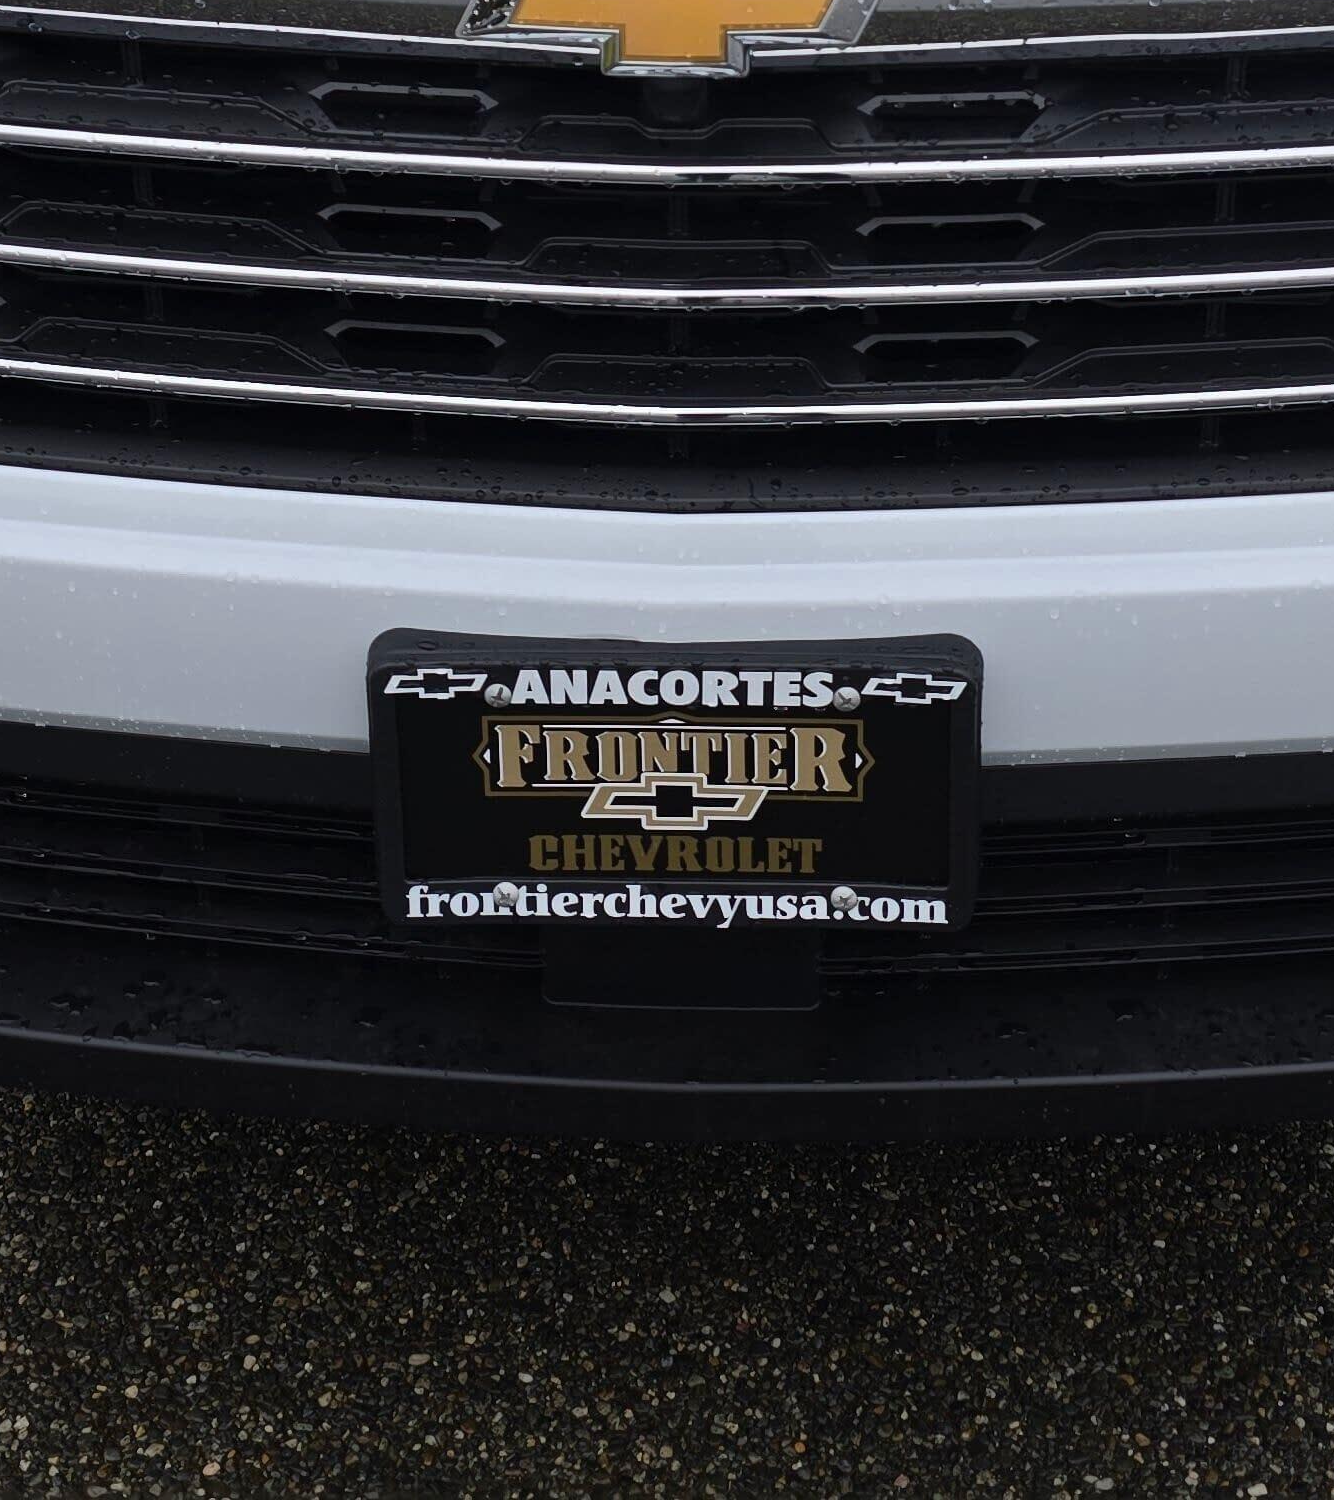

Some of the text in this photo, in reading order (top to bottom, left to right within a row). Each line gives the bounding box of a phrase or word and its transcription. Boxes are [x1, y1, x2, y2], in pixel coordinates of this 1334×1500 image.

[510, 669, 835, 708] ANACORTES
[495, 723, 852, 793] FRONTIER
[528, 834, 823, 874] CHEVROLET
[405, 884, 949, 928] frontierchevyusa.com
